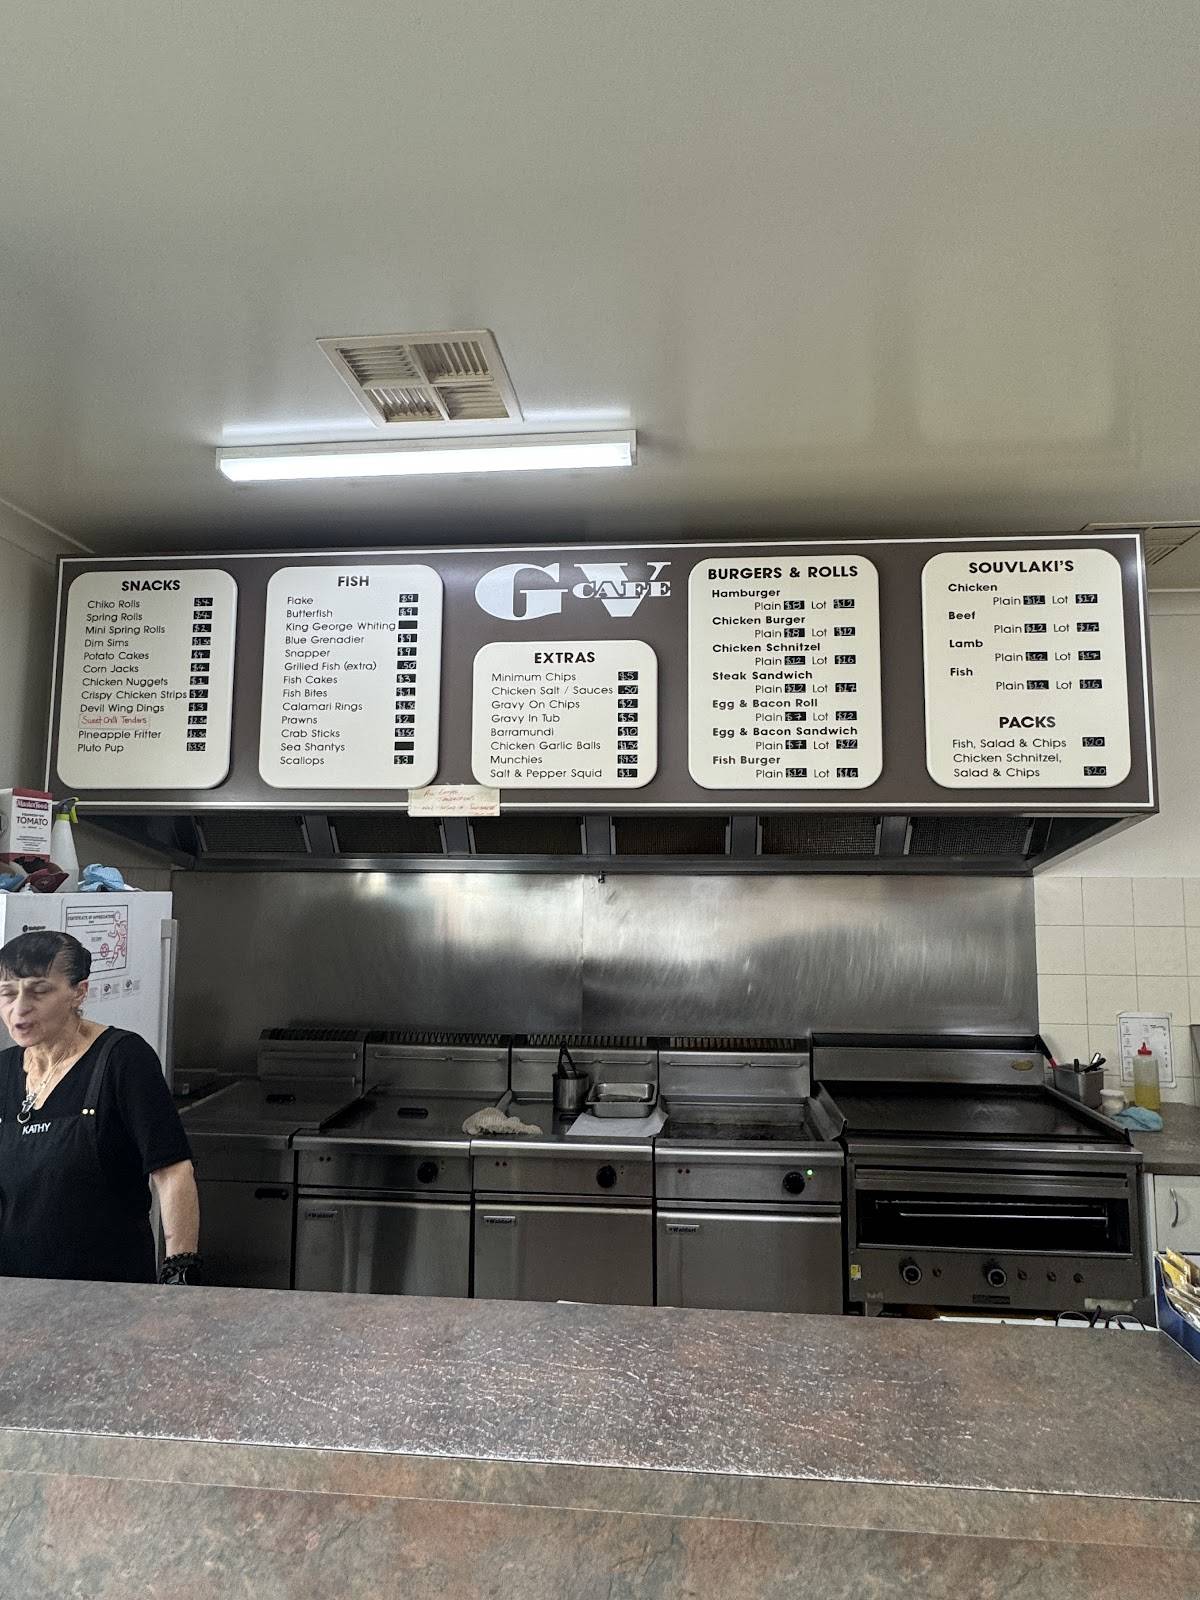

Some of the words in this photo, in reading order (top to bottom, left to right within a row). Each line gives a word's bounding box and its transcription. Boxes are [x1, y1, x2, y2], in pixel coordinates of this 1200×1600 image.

[969, 560, 1074, 573] SOUVLAKI'S
[708, 567, 782, 579] BURGERS
[790, 567, 800, 578] &
[808, 566, 858, 577] ROLLS
[122, 580, 180, 591] SNACKS
[338, 576, 369, 587] FISH
[948, 583, 997, 592] Chicken
[712, 589, 780, 599] Hamburger
[88, 600, 115, 608] Chiko
[119, 600, 140, 608] Rolls
[993, 597, 1021, 605] Plain
[1052, 596, 1068, 604] Lot
[755, 602, 781, 610] Plain
[812, 601, 826, 609] Lot
[86, 613, 118, 623] Spring
[121, 613, 142, 621] Rolls
[287, 609, 332, 618] Butterfish
[949, 611, 975, 619] Beef
[712, 616, 761, 625] Chicken
[766, 616, 805, 626] Burger
[85, 626, 106, 634] Mini
[109, 626, 140, 635] Spring
[144, 625, 165, 633] Rolls
[286, 623, 308, 632] King
[312, 622, 353, 632] George
[357, 622, 395, 631] Whiting
[994, 625, 1022, 633] Plain
[1054, 624, 1069, 632] Lot
[755, 630, 781, 638] Plain
[812, 629, 827, 637] Lot
[85, 639, 104, 647] Dim
[107, 639, 128, 647] Sims
[285, 636, 306, 644] Blue
[311, 636, 364, 644] Grenadier
[950, 639, 983, 648] Lamb
[713, 644, 761, 652] Chicken
[767, 643, 820, 651] Schnitzel
[84, 652, 114, 660] Potato
[118, 652, 149, 660] Cakes
[285, 649, 330, 659] Snapper
[535, 652, 595, 663] EXTRAS
[995, 653, 1023, 661] Plain
[1055, 652, 1071, 661] Lot
[755, 657, 782, 665] Plain
[812, 656, 827, 664] Lot
[83, 665, 107, 673] Corn
[110, 665, 139, 673] Jacks
[284, 662, 318, 671] Grilled
[322, 662, 340, 670] Fish
[344, 661, 376, 671] (extra)
[713, 672, 746, 680] Steak
[752, 671, 812, 679] Sandwich
[950, 668, 973, 676] Fish
[284, 676, 301, 684] Fish
[305, 676, 337, 684] Cakes
[397, 675, 411, 683] $3
[492, 673, 541, 681] Minimum
[546, 673, 576, 682] Chips
[82, 678, 123, 686] Chicken
[126, 678, 168, 687] Nuggets
[996, 681, 1024, 690] Plain
[1056, 681, 1072, 689] Lot
[283, 689, 301, 697] Fish
[305, 689, 327, 697] Bites
[492, 687, 536, 695] Chicken
[540, 686, 559, 695] Salt
[564, 686, 569, 694] /
[573, 686, 613, 694] Sauces
[756, 685, 782, 693] Plain
[813, 684, 828, 693] Lot
[81, 691, 112, 700] Crispy
[116, 691, 157, 699] Chicken
[161, 691, 187, 700] Strips
[191, 690, 204, 698] $2
[80, 704, 104, 712] Devil
[108, 704, 133, 713] Wing
[137, 704, 164, 713] Dings
[283, 702, 331, 711] Calamari
[335, 702, 362, 712] Rings
[492, 701, 524, 710] Gravy
[529, 700, 545, 708] On
[549, 700, 580, 710] Chips
[713, 700, 734, 710] Egg
[753, 699, 790, 707] Bacon
[796, 699, 817, 707] Roll
[282, 716, 317, 724] Prawns
[492, 714, 524, 724] Gravy
[529, 714, 537, 722] In
[542, 714, 560, 722] Tub
[756, 713, 782, 721] Plain
[813, 712, 828, 721] Lot
[1000, 716, 1056, 728] PACKS
[79, 729, 131, 740] Pineapple
[134, 729, 161, 738] Fritter
[281, 729, 307, 738] Crab
[311, 729, 340, 737] Sticks
[491, 728, 553, 736] Barramundi
[713, 728, 734, 738] Egg
[796, 726, 857, 735] Sandwich
[281, 743, 301, 751] Sea
[305, 743, 345, 752] Shantys
[491, 742, 535, 750] Chicken
[539, 741, 572, 750] Garlic
[577, 741, 600, 749] Balls
[756, 742, 783, 750] Plain
[814, 741, 828, 749] Lot
[953, 739, 975, 749] Fish,
[981, 739, 1015, 748] Salad
[1019, 739, 1027, 747] &
[1033, 738, 1066, 749] Chips
[78, 744, 101, 752] Pluto
[105, 744, 124, 754] Pup
[280, 756, 324, 766] Scallops
[491, 755, 542, 764] Munchies
[713, 756, 735, 764] Fish
[741, 756, 780, 766] Burger
[953, 754, 1002, 762] Chicken
[1006, 753, 1061, 763] Schnitzel,
[490, 769, 510, 778] Salt
[515, 769, 522, 777] &
[527, 769, 566, 779] Pepper
[571, 769, 602, 779] Squid
[756, 770, 783, 778] Plain
[814, 769, 828, 778] Lot
[954, 769, 988, 777] Salad
[993, 768, 1001, 777] &
[1006, 768, 1040, 778] Chips
[17, 817, 48, 826] TOMATO
[22, 1122, 51, 1135] KATHY
